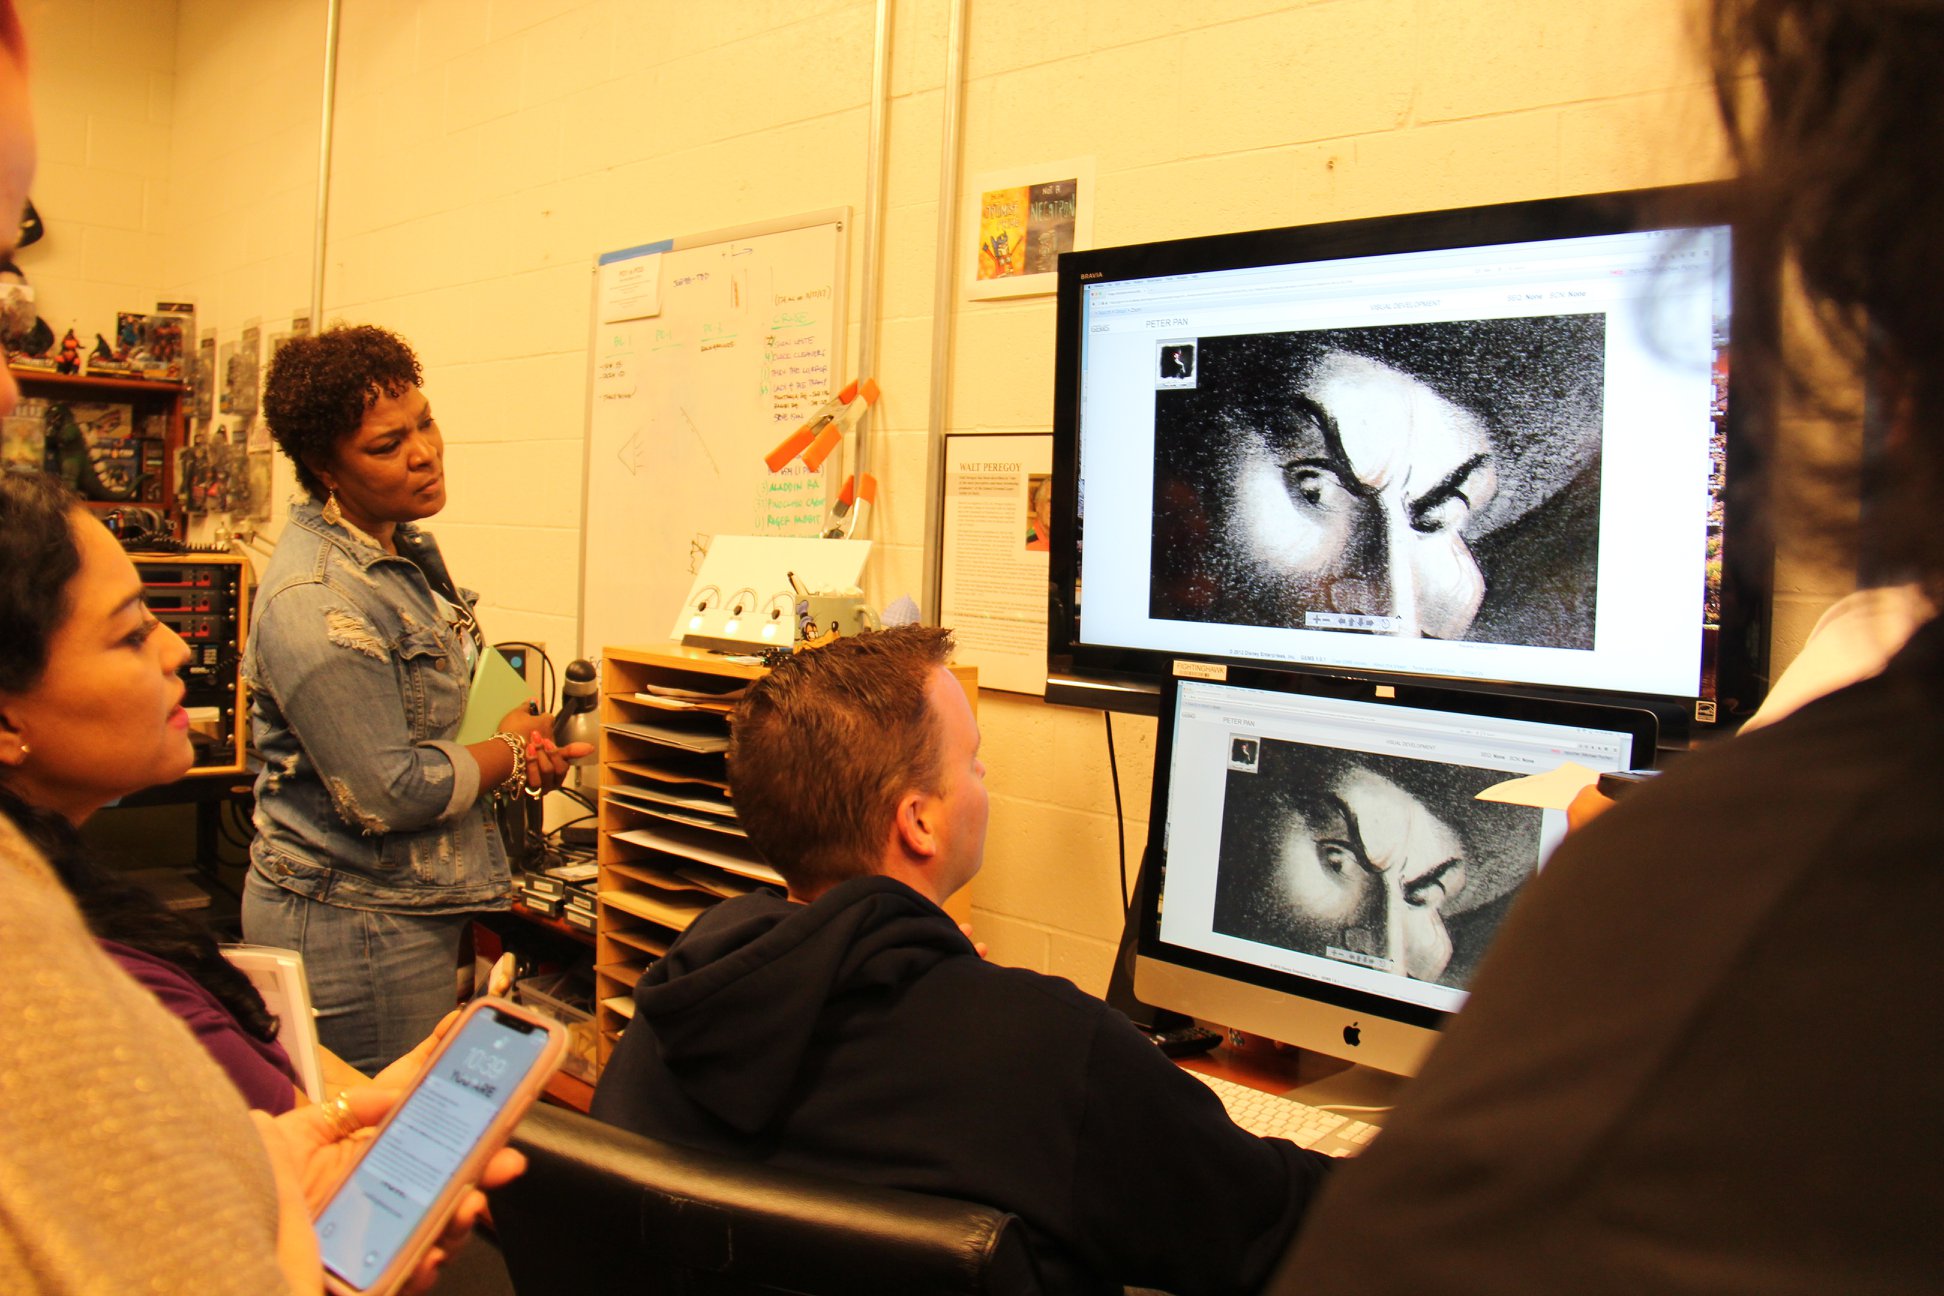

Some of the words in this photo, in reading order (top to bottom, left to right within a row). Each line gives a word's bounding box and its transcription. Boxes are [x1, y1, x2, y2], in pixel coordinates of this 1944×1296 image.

[1042, 186, 1053, 195] NOT
[1081, 272, 1103, 280] BRAVIA
[1146, 319, 1171, 328] PETER
[1173, 317, 1189, 326] PAN
[960, 463, 980, 472] WALT
[983, 463, 1021, 472] PEREGOY
[1177, 662, 1224, 673] FIGHTINGHAWK
[1223, 716, 1241, 725] PETER
[1242, 719, 1255, 727] PAN
